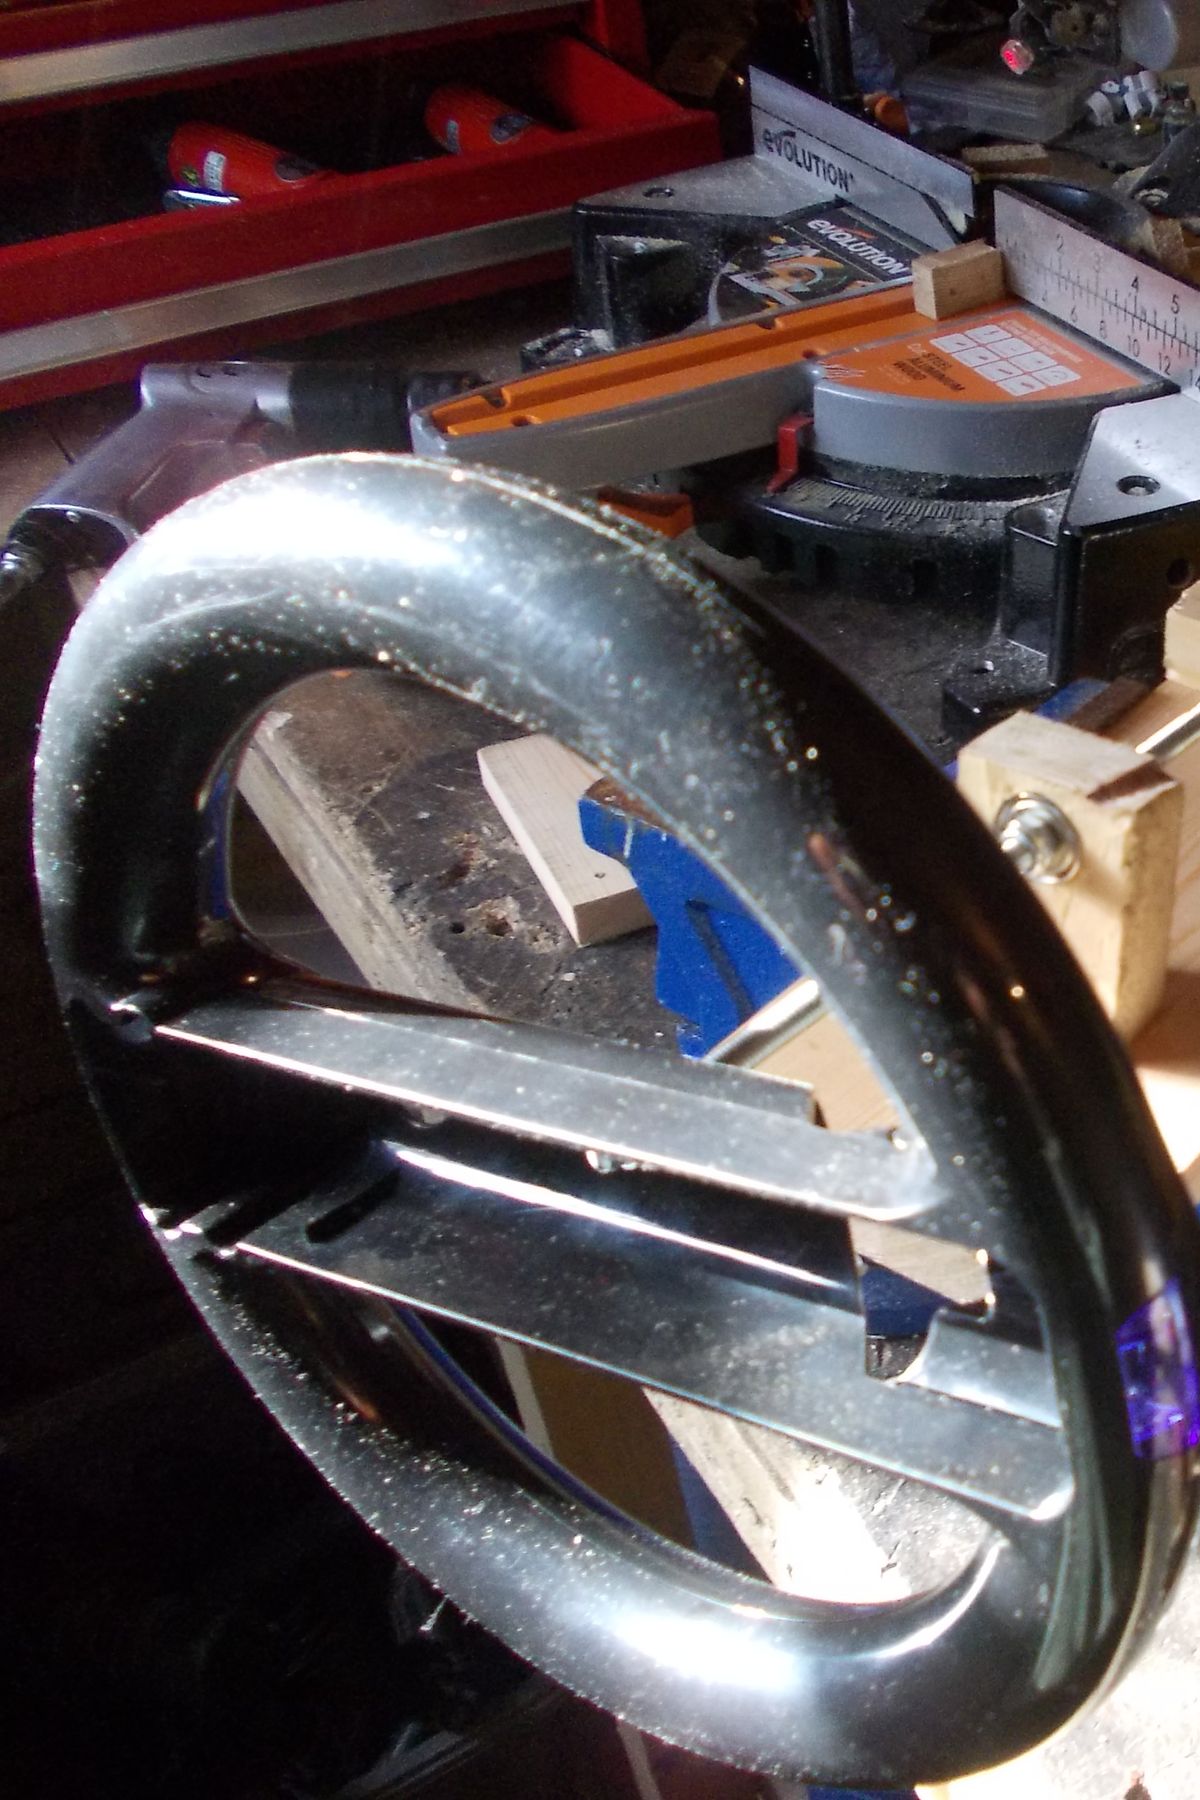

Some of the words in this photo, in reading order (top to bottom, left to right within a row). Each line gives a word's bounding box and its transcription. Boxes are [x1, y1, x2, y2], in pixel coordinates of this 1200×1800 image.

[1131, 276, 1140, 293] 4
[1170, 294, 1180, 315] 5
[1070, 305, 1079, 324] 6
[1127, 335, 1140, 358] 10
[1158, 352, 1171, 376] 12
